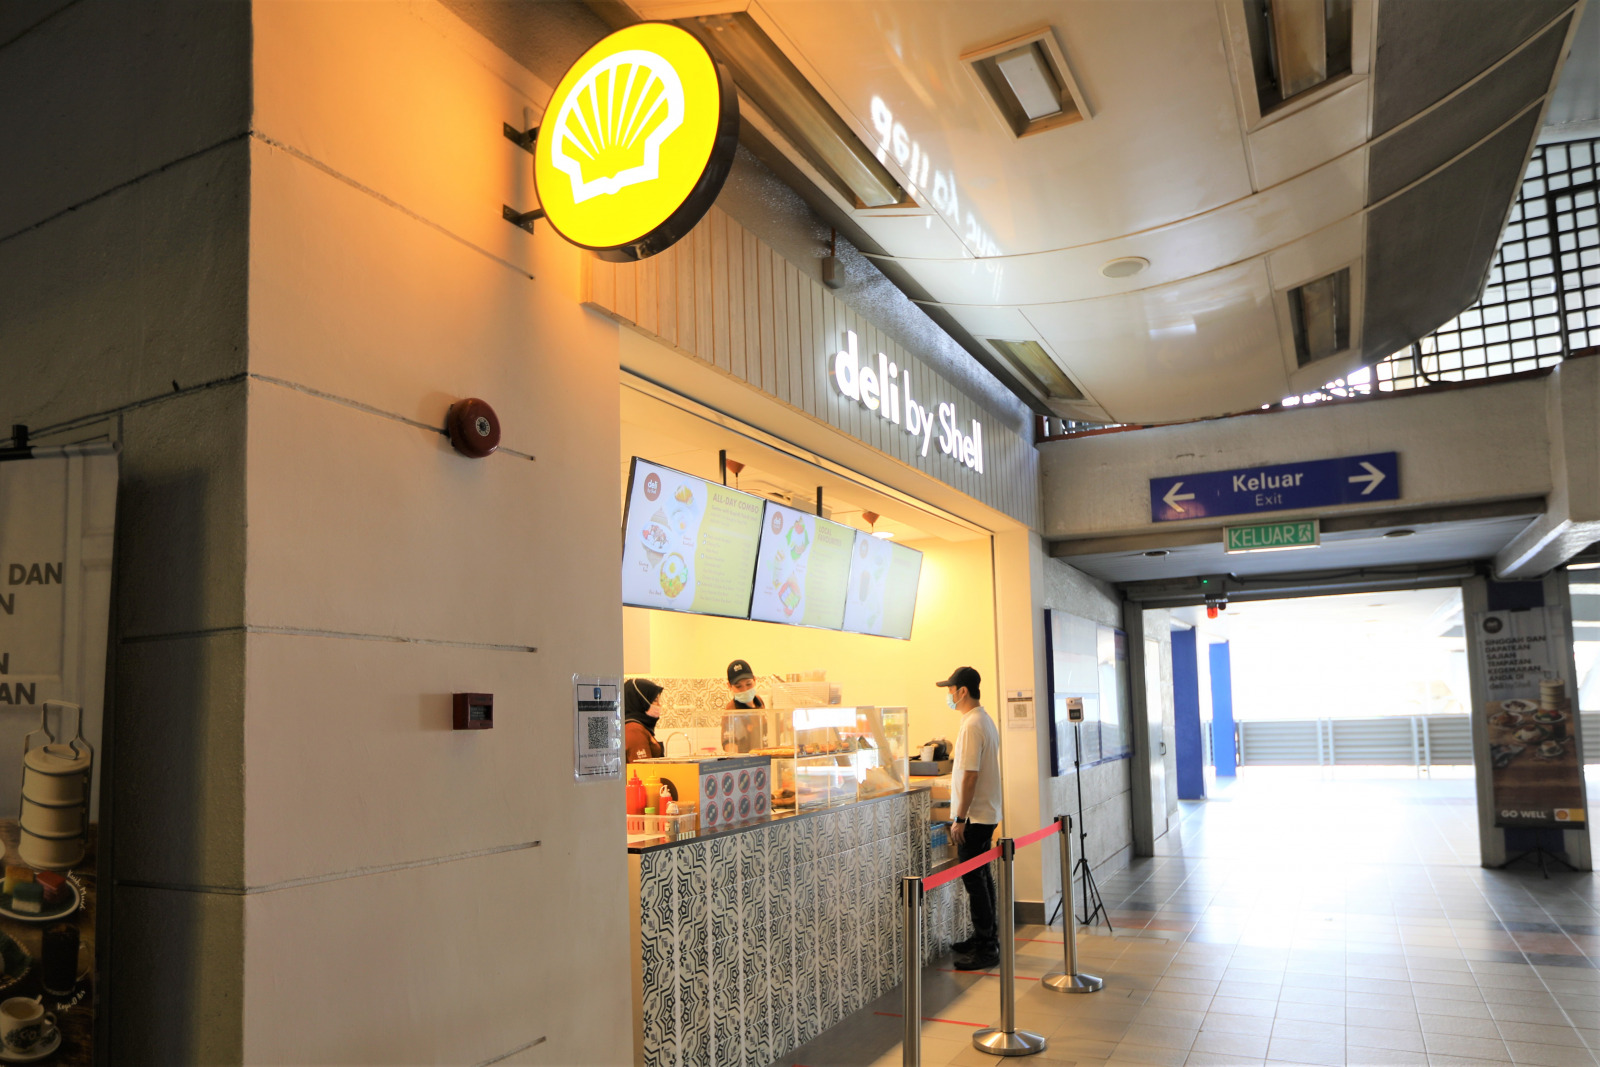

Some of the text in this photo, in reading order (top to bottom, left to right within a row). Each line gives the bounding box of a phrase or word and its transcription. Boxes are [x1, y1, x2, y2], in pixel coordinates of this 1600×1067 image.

[835, 330, 983, 474] deli by Shell
[1232, 471, 1303, 492] Keluar
[713, 493, 737, 508] ALL-DAY
[738, 500, 759, 514] COMBO
[1255, 493, 1283, 506] Exit
[1231, 525, 1294, 547] KELUAR
[8, 562, 63, 586] DAN
[1526, 634, 1547, 642] DAN
[1501, 809, 1546, 819] GO WELL
